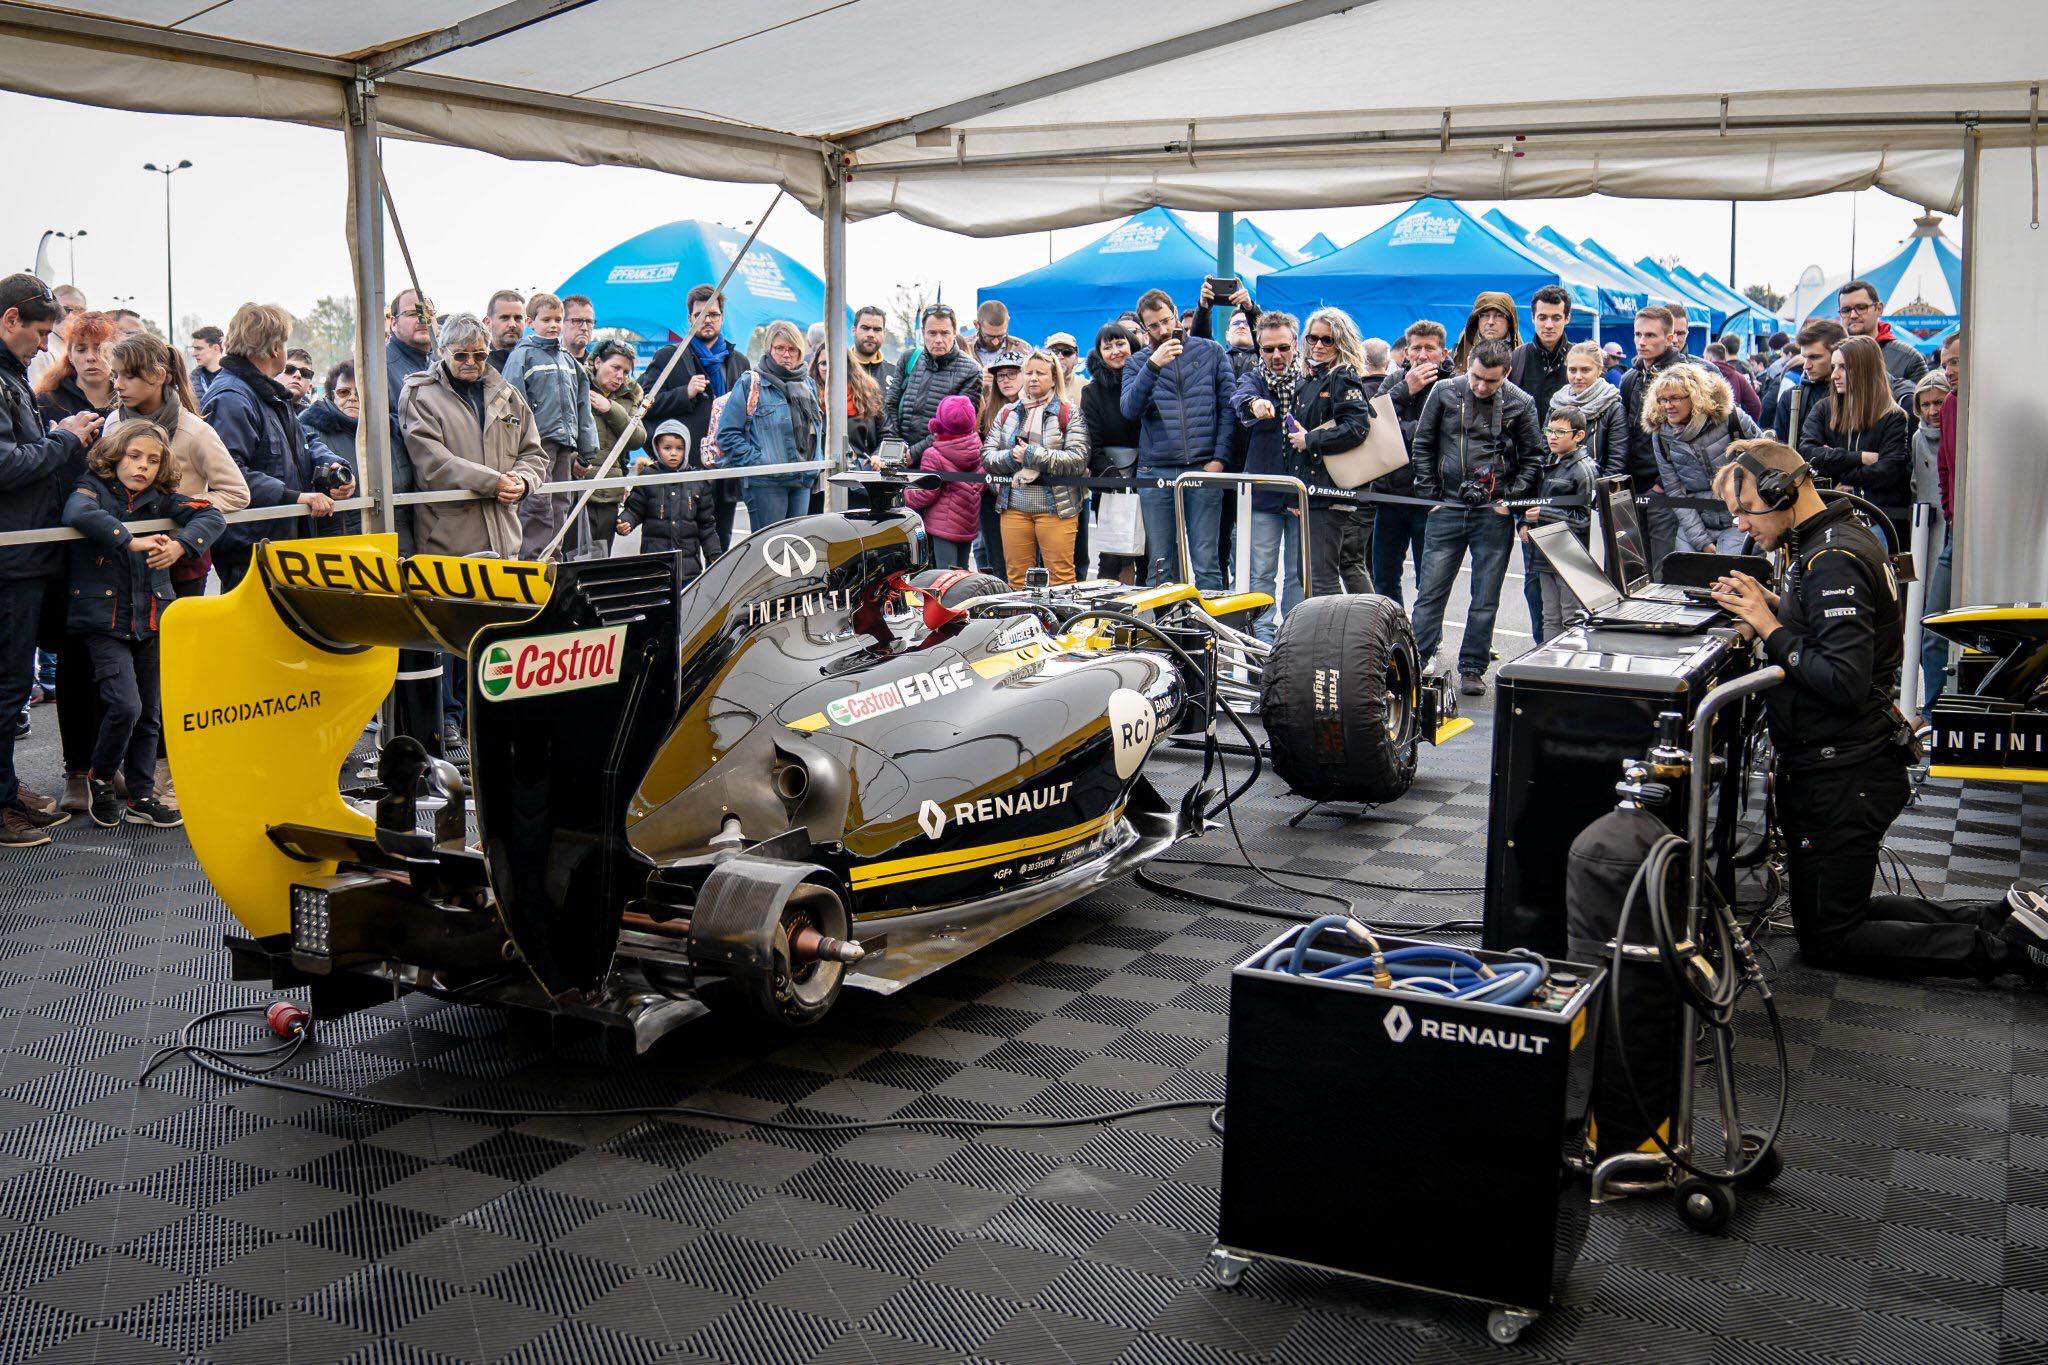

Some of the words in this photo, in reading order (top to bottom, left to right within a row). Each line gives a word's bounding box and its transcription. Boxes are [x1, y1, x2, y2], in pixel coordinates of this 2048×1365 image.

[1166, 480, 1204, 488] REAULT
[1317, 487, 1356, 498] RENAULT
[1511, 498, 1553, 506] RENAULT
[276, 550, 539, 605] RENAULT
[749, 588, 850, 626] INFINITI
[1824, 607, 1857, 618] PIRELLI
[516, 634, 617, 690] Castrol
[847, 684, 901, 719] Castrol
[897, 662, 974, 708] EDGE
[1154, 695, 1174, 713] BANK
[1313, 669, 1326, 711] Right
[1329, 668, 1340, 711] Front
[183, 690, 321, 732] EURODATACAR
[1931, 730, 2042, 752] INFINI
[954, 781, 1073, 826] RENAULT
[1421, 1018, 1550, 1055] RENAULT
